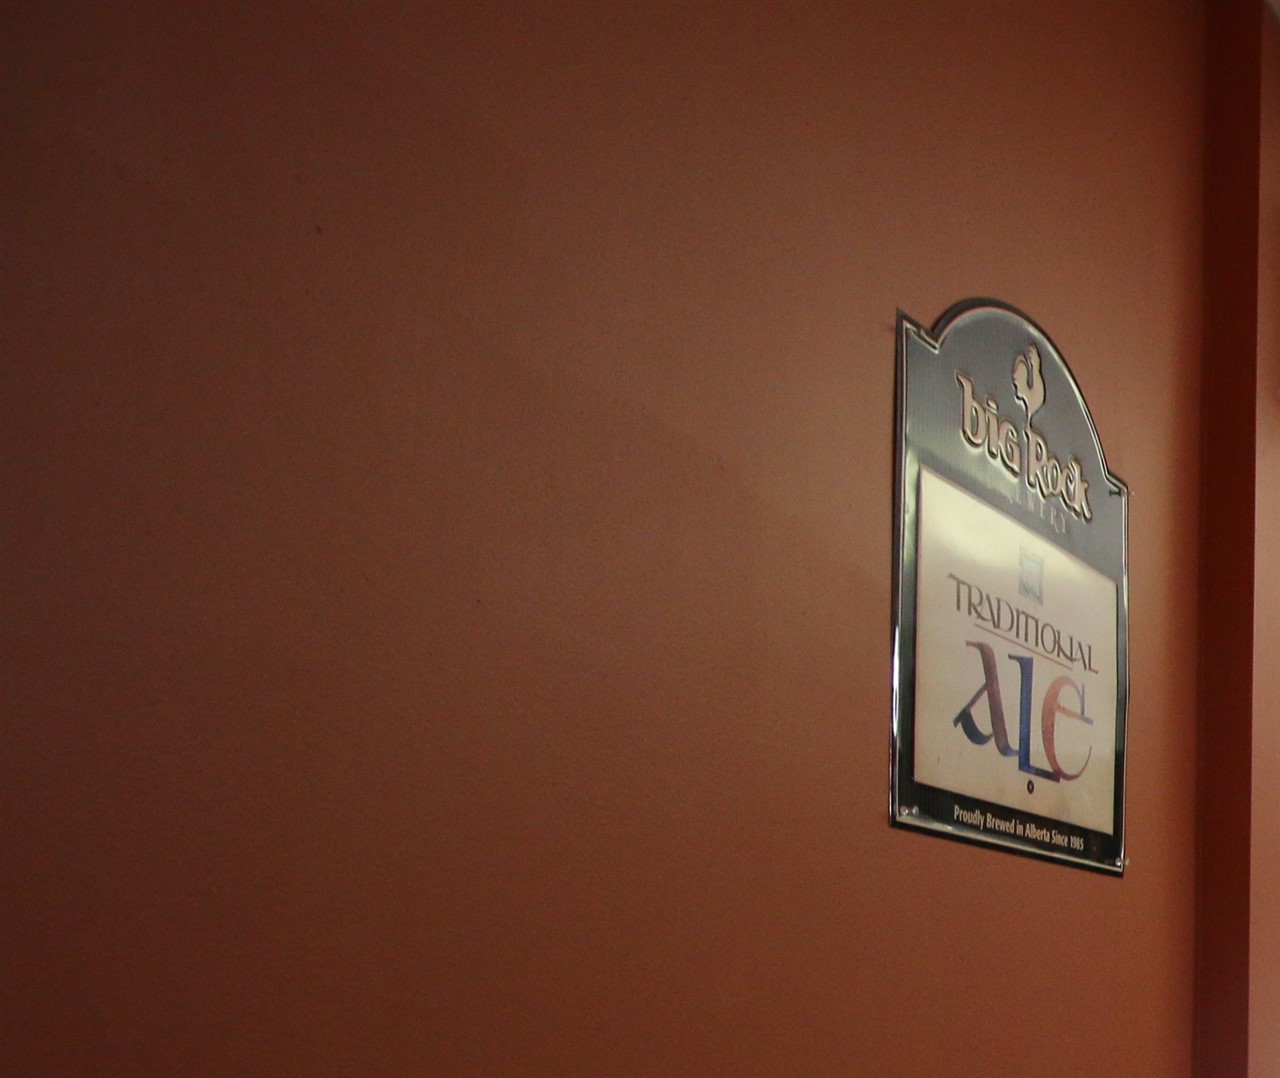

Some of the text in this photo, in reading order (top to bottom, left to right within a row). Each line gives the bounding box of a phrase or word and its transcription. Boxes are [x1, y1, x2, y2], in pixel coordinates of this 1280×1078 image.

[947, 572, 1099, 675] TRADITIONAL
[954, 805, 1084, 851] Proudly Brewed in Alberta Since 1985
